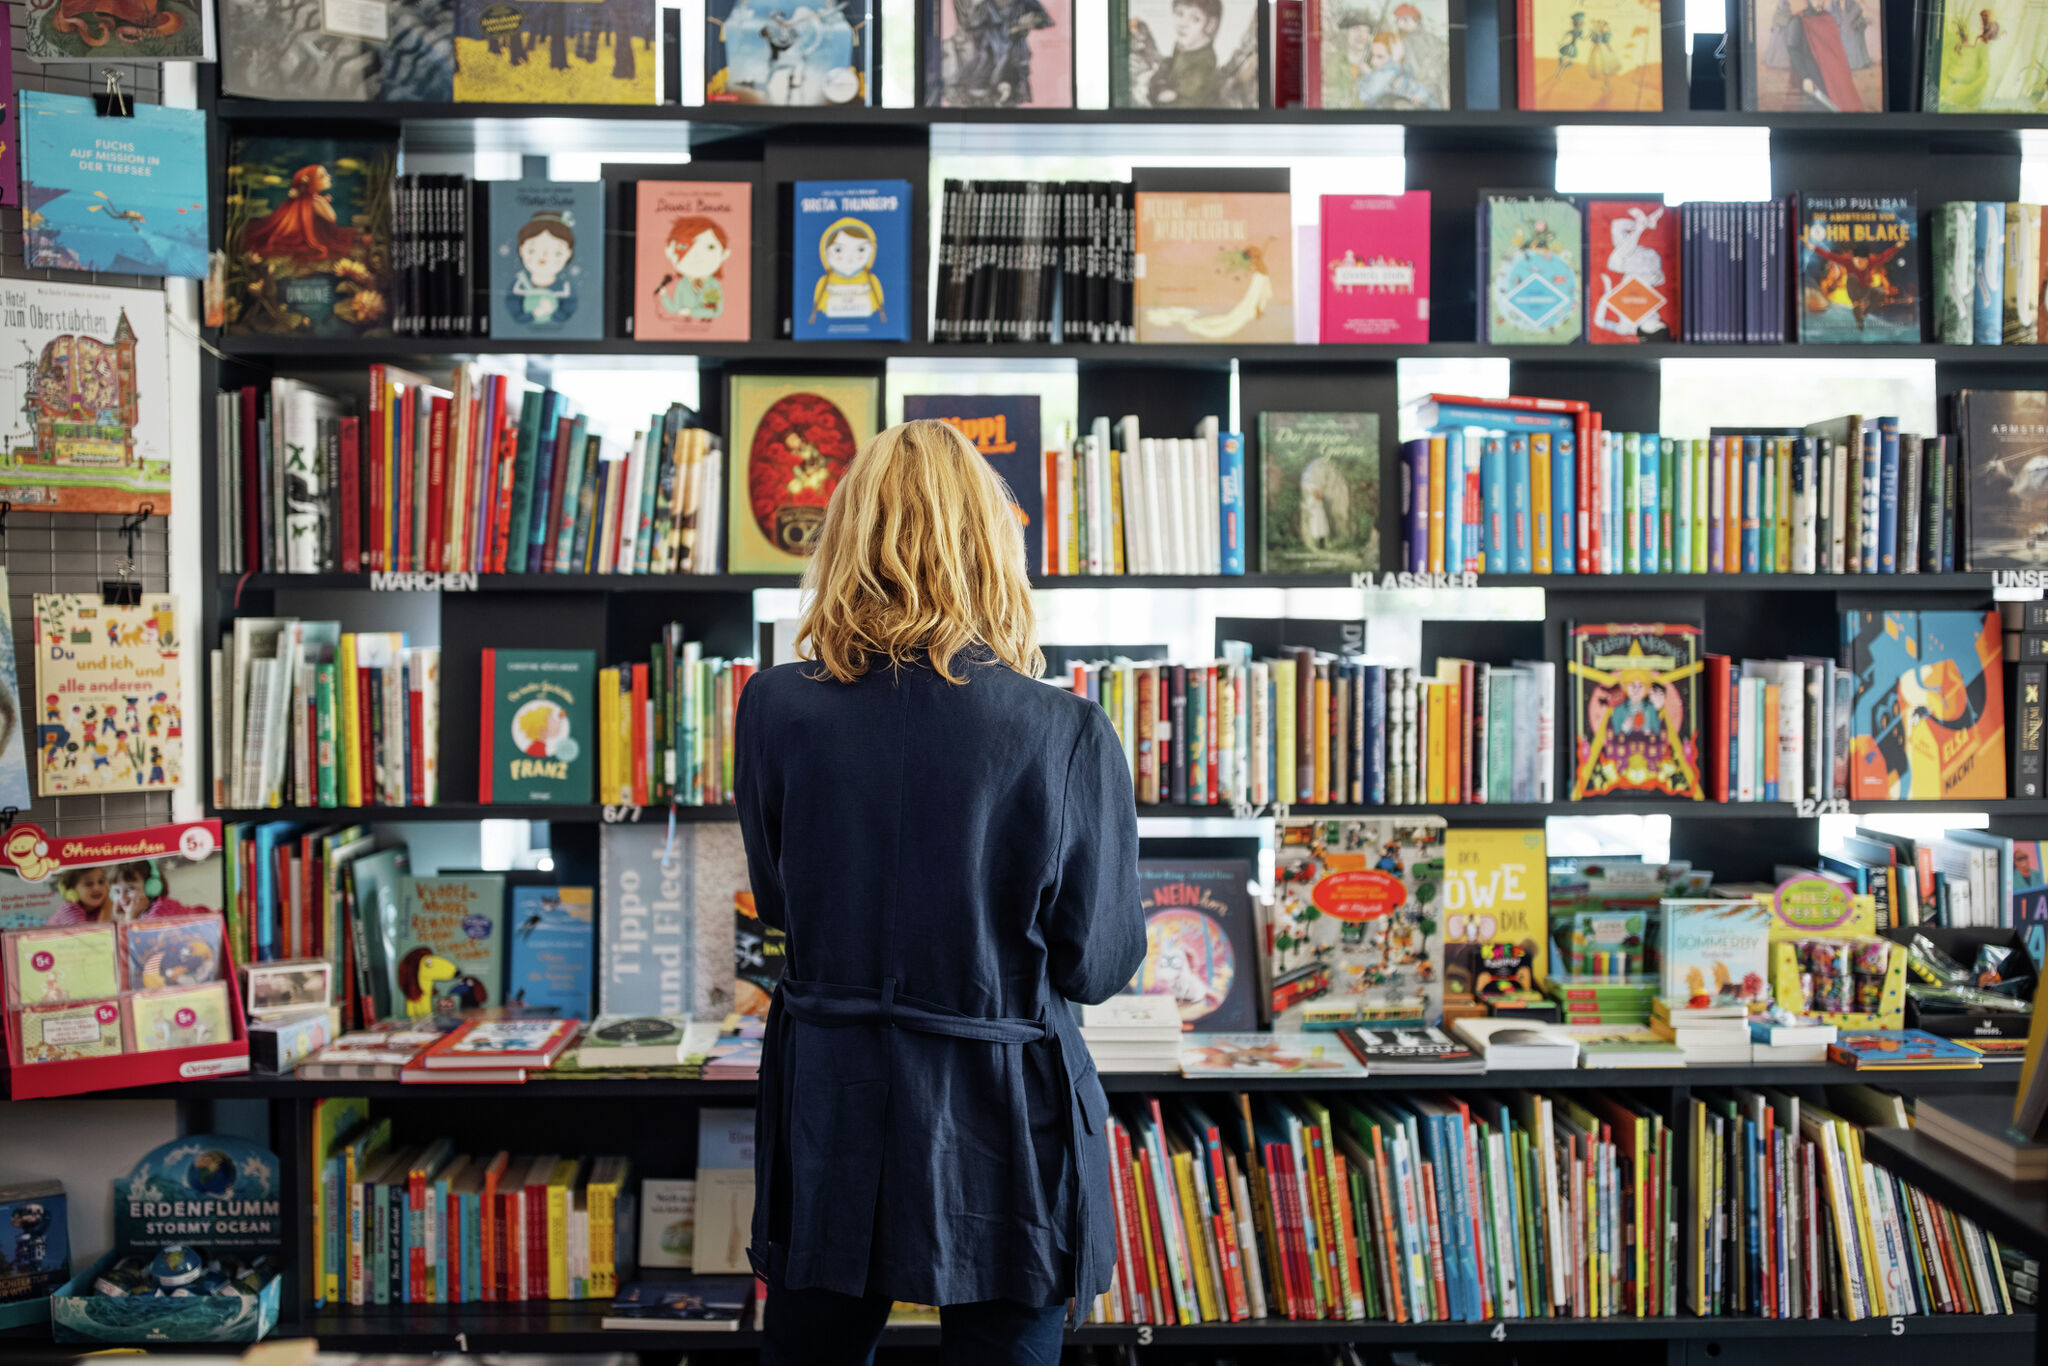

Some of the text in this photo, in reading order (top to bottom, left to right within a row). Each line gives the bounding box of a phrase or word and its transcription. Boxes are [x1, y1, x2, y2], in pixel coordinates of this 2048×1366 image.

[95, 139, 135, 152] FUCHS
[70, 148, 160, 166] AUF MISSION IN
[79, 160, 151, 176] DER TIEFSEE
[1807, 198, 1908, 209] PHILIP PULLMAN
[1853, 224, 1911, 242] BLAKE
[5, 290, 27, 308] Hotel
[4, 304, 109, 334] zum Oberstübchen
[1992, 424, 2048, 434] ARMSTR
[1351, 571, 1479, 590] KLASSIKER
[51, 646, 75, 660] Du
[77, 655, 134, 671] und ich
[135, 663, 165, 678] und
[58, 676, 152, 693] alle anderen
[1944, 727, 1970, 764] ELSA
[510, 758, 568, 780] FRANZ
[1944, 754, 1976, 793] NACHT
[603, 805, 642, 823] 6/7
[1794, 800, 1851, 817] 12/13
[1443, 863, 1527, 909] ÖWE
[612, 869, 648, 984] Tippo
[652, 837, 681, 1016] und Fleck
[145, 1220, 272, 1235] STORMY OCEAN
[1137, 1326, 1154, 1345] 3
[1490, 1323, 1507, 1341] 4
[1891, 1317, 1906, 1337] 5
[455, 1332, 468, 1352] 1
